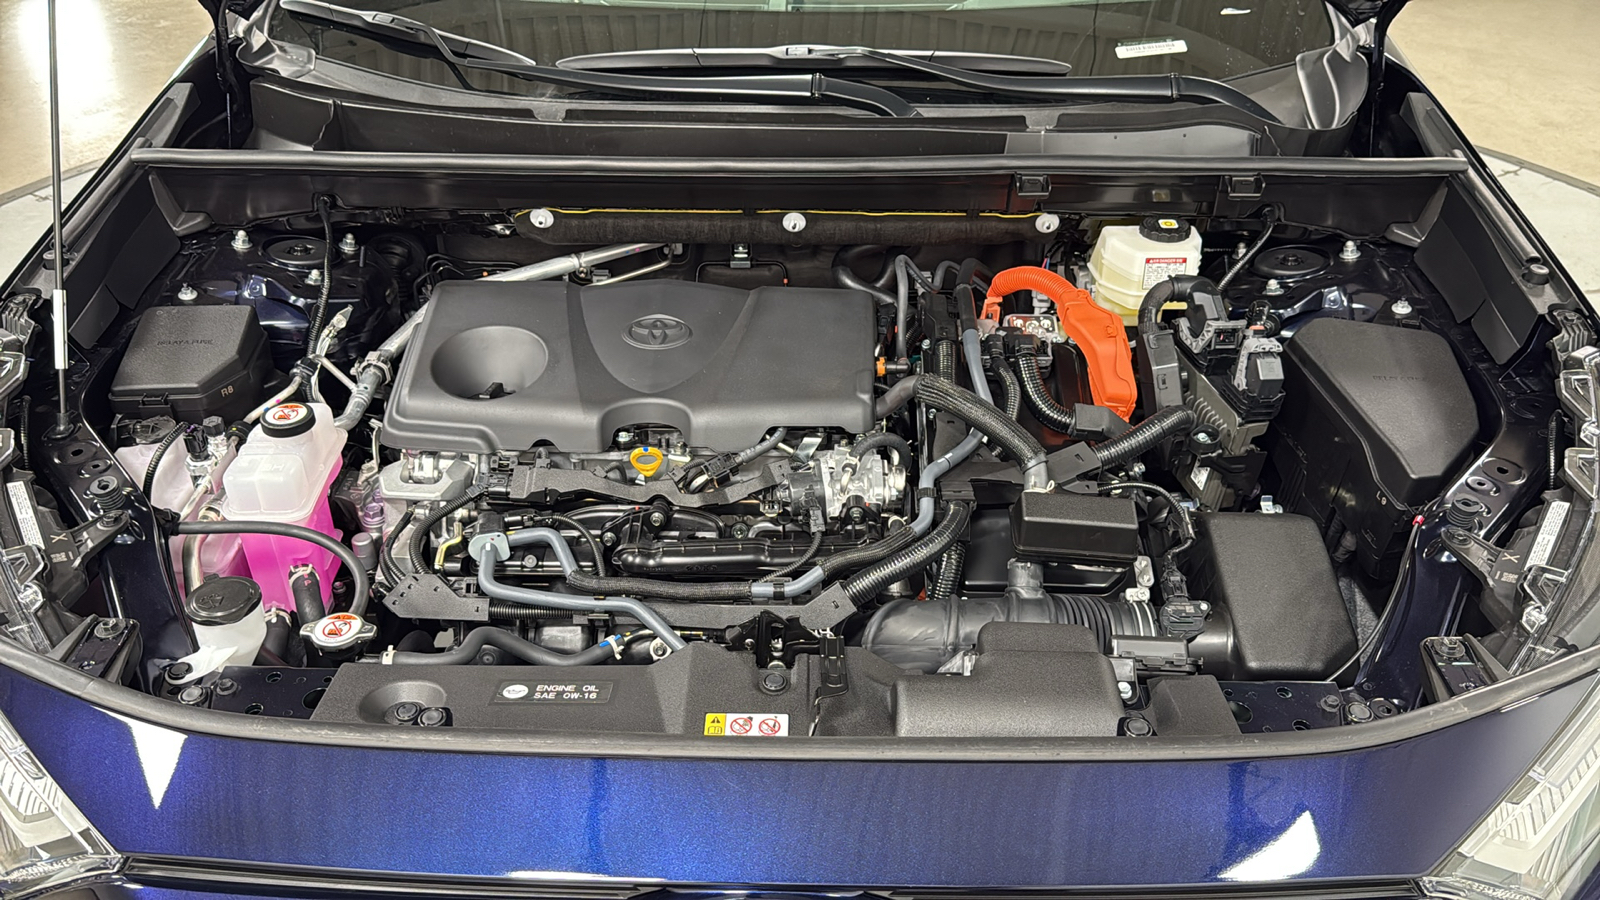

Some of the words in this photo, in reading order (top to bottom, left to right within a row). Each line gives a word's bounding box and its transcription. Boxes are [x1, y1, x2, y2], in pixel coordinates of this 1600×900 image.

[220, 385, 234, 397] R8
[536, 684, 577, 692] ENGINE
[582, 684, 600, 692] OIL
